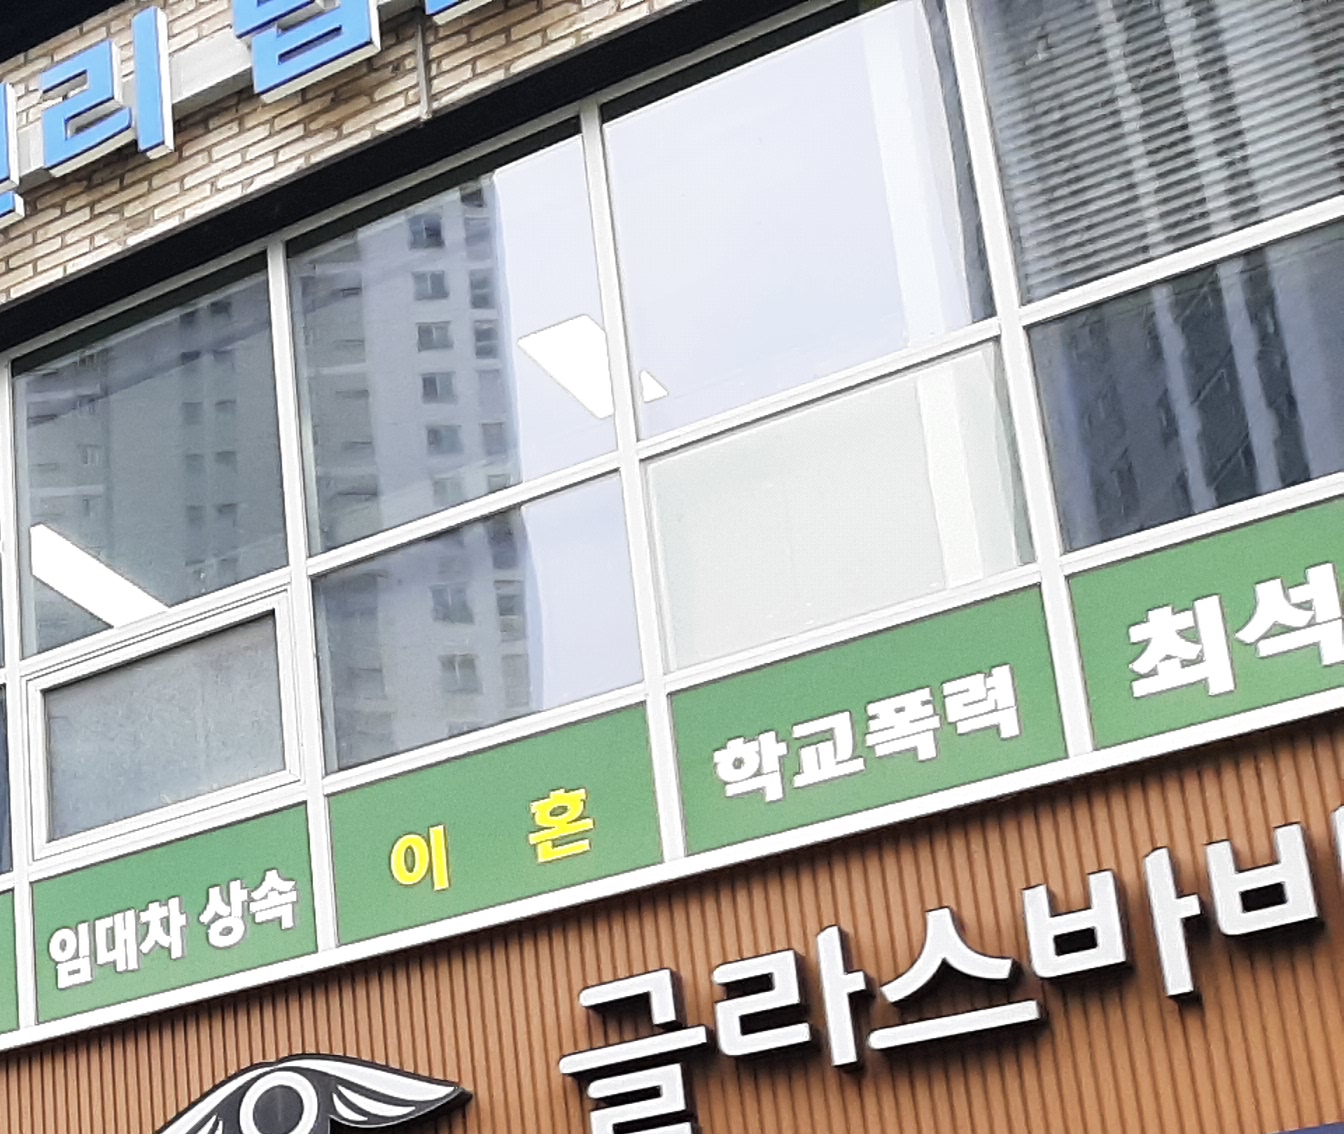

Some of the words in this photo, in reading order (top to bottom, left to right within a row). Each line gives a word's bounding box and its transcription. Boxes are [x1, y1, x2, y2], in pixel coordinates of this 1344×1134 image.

[45, 888, 192, 992] 임대차
[198, 864, 301, 962] 상속
[711, 661, 1025, 806] 학교폭력
